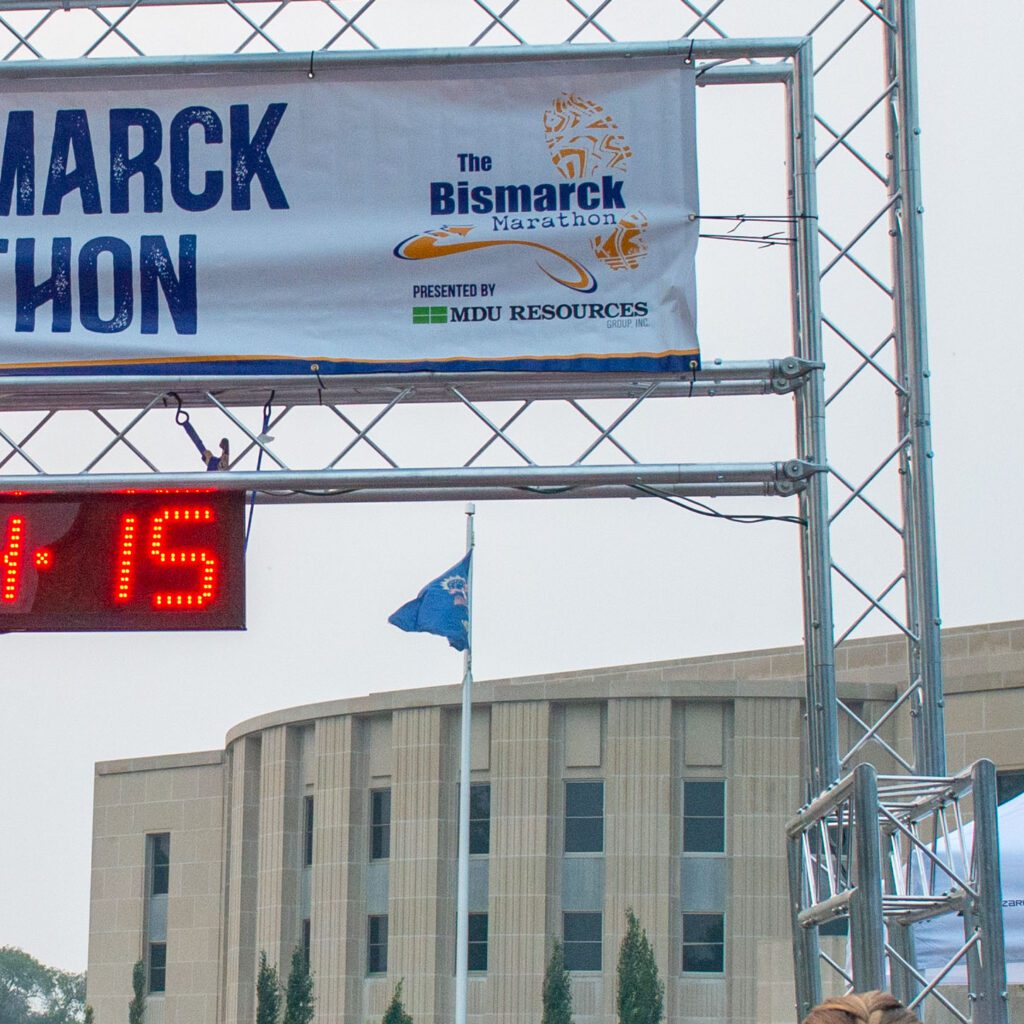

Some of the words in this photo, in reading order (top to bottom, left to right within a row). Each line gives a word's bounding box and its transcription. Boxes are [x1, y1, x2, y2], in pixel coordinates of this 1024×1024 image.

[457, 153, 492, 172] The
[430, 175, 626, 216] Bismarck
[492, 212, 618, 232] Marathon
[413, 284, 477, 298] PRESENTED
[480, 283, 496, 297] BY
[450, 306, 503, 323] MDU
[509, 302, 649, 321] RESOURCES
[115, 506, 218, 608] 15
